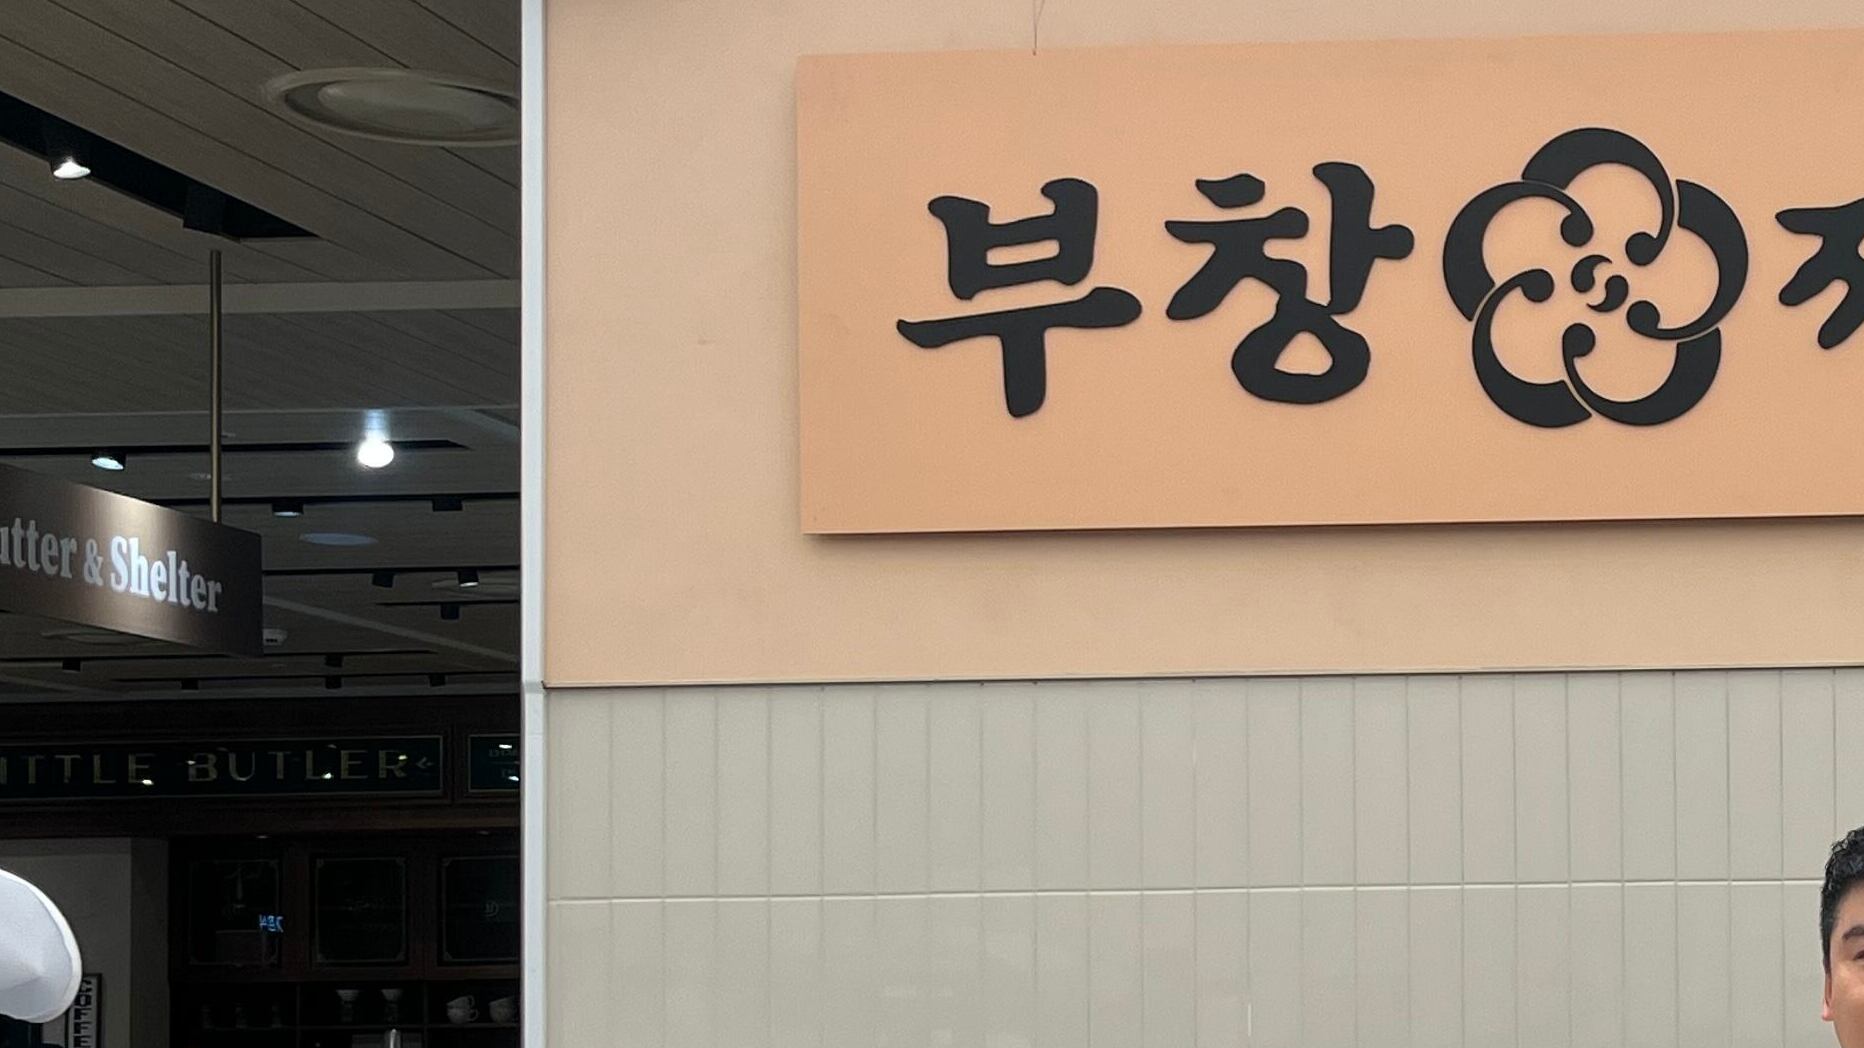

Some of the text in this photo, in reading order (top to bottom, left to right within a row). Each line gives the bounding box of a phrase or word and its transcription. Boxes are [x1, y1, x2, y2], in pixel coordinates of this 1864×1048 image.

[898, 161, 1414, 417] 부창
[84, 538, 103, 587] &
[110, 536, 222, 612] Shelter
[187, 749, 408, 783] BUTLER
